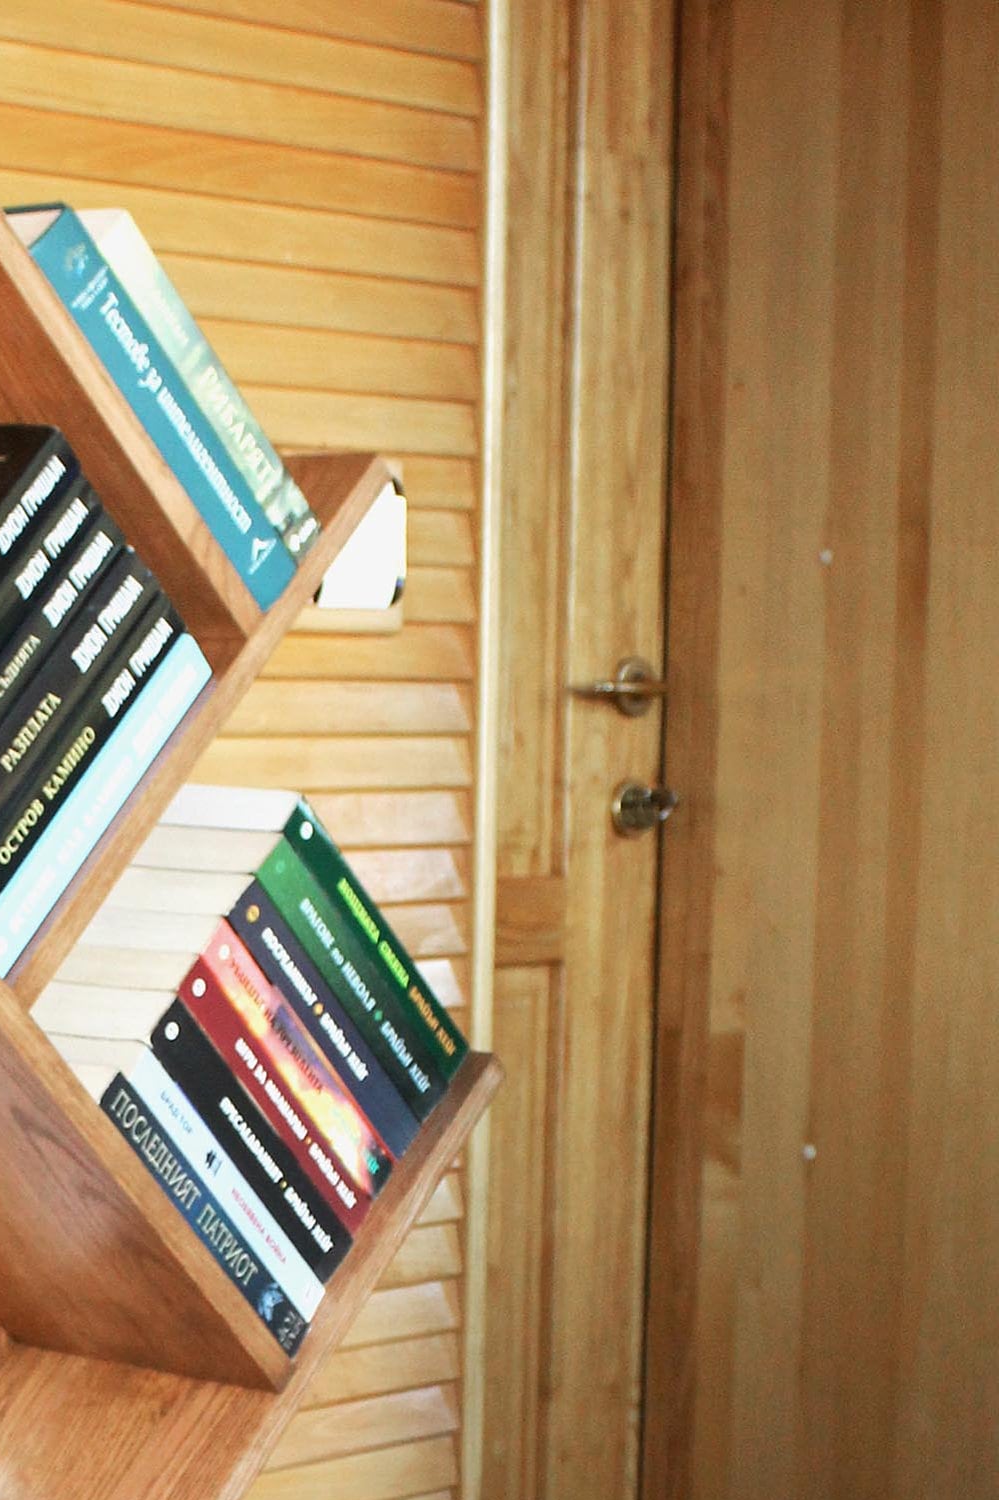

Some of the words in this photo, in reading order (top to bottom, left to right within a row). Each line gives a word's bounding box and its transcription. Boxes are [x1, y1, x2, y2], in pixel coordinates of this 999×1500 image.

[1, 690, 58, 773] РАЗПЛАТА
[42, 724, 95, 801] КАМИНО
[108, 1087, 200, 1211] ПОСЛЕДНИЯТ
[195, 1201, 257, 1287] ПАТРИОТ
